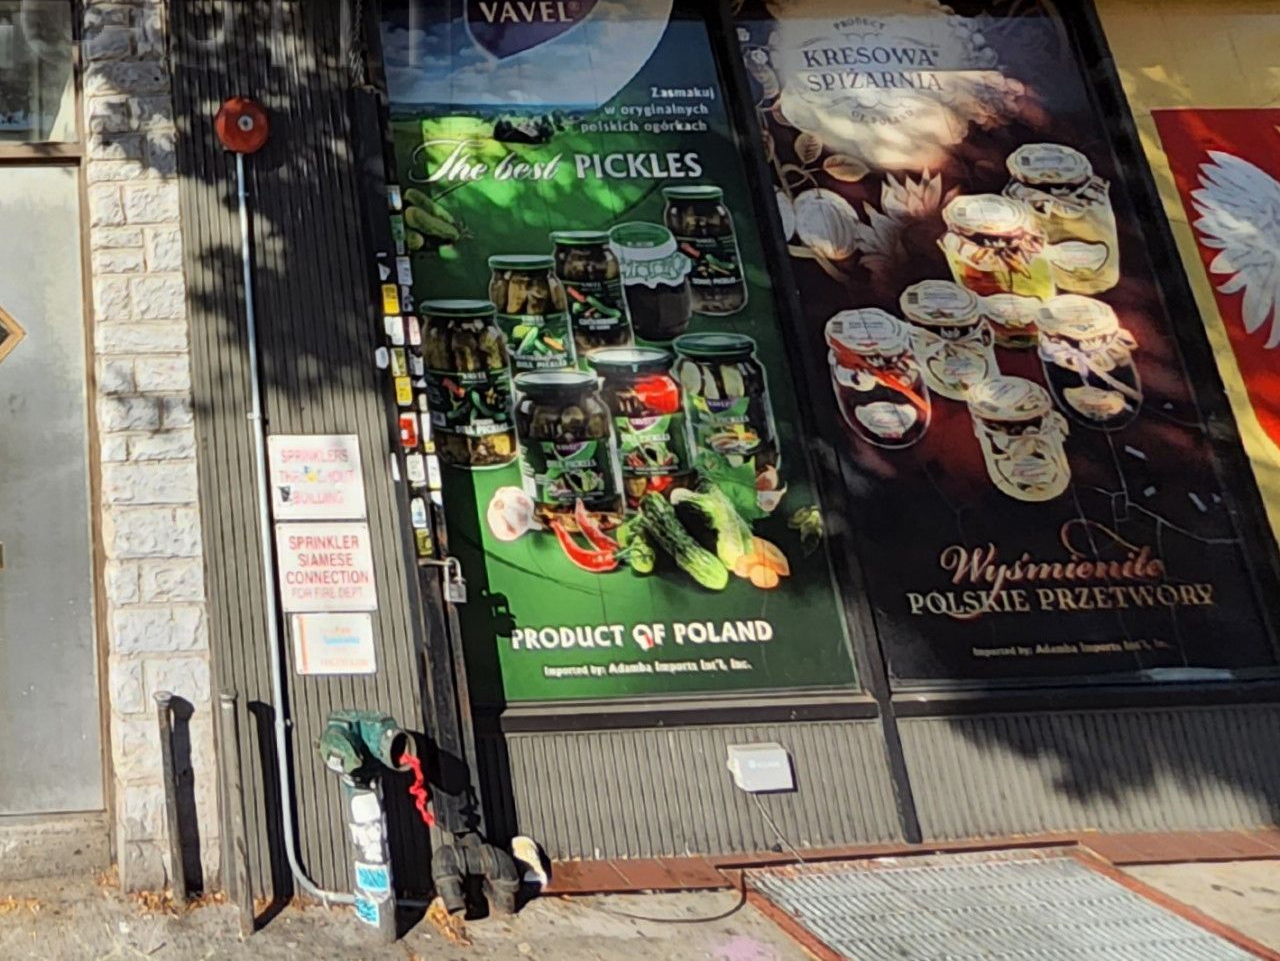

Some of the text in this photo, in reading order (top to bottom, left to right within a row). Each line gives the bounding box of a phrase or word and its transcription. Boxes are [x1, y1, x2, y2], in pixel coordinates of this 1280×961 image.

[479, 1, 574, 23] VAVEL
[802, 45, 936, 69] KRESOWA
[650, 86, 716, 100] Zasmakuj
[603, 103, 709, 118] w oryginalnych
[580, 120, 640, 134] polskich
[409, 138, 704, 184] The best PICKLES
[288, 535, 360, 551] SPRINKLER
[297, 552, 354, 568] SIAMESE
[286, 570, 369, 585] CONNECTION
[906, 583, 1216, 616] POLSKIE PRZETWORY
[511, 620, 774, 651] PRODUCT OF POLAND
[544, 665, 589, 678] Imported
[590, 665, 607, 678] by:
[608, 662, 653, 675] Adamba
[655, 660, 699, 673] Imports
